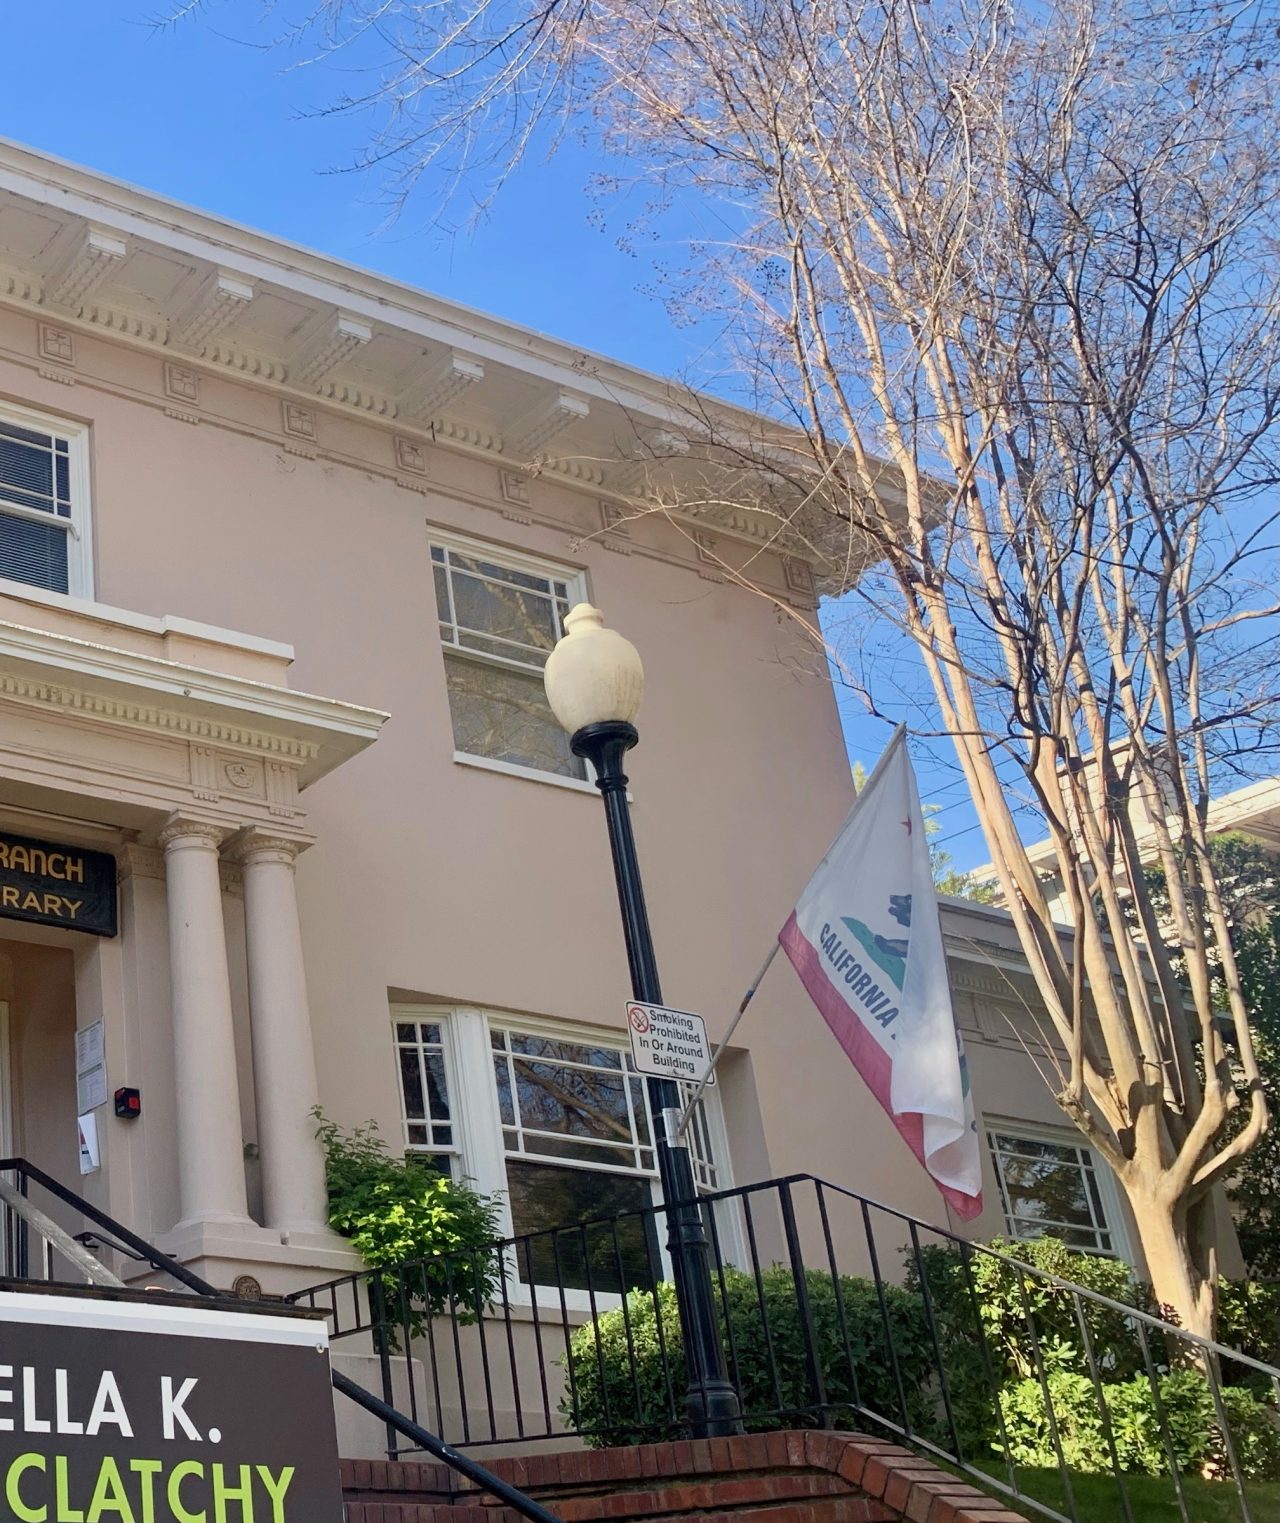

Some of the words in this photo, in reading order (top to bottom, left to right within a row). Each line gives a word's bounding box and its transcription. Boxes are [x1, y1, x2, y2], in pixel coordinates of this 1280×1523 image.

[819, 923, 899, 1029] CALIFORNIA
[649, 1009, 694, 1030] Smoking
[649, 1024, 701, 1043] Prohibited
[639, 1037, 649, 1048] In
[652, 1038, 664, 1050] Or
[667, 1042, 703, 1058] Around
[652, 1053, 695, 1073] Building
[160, 1375, 222, 1444] K.
